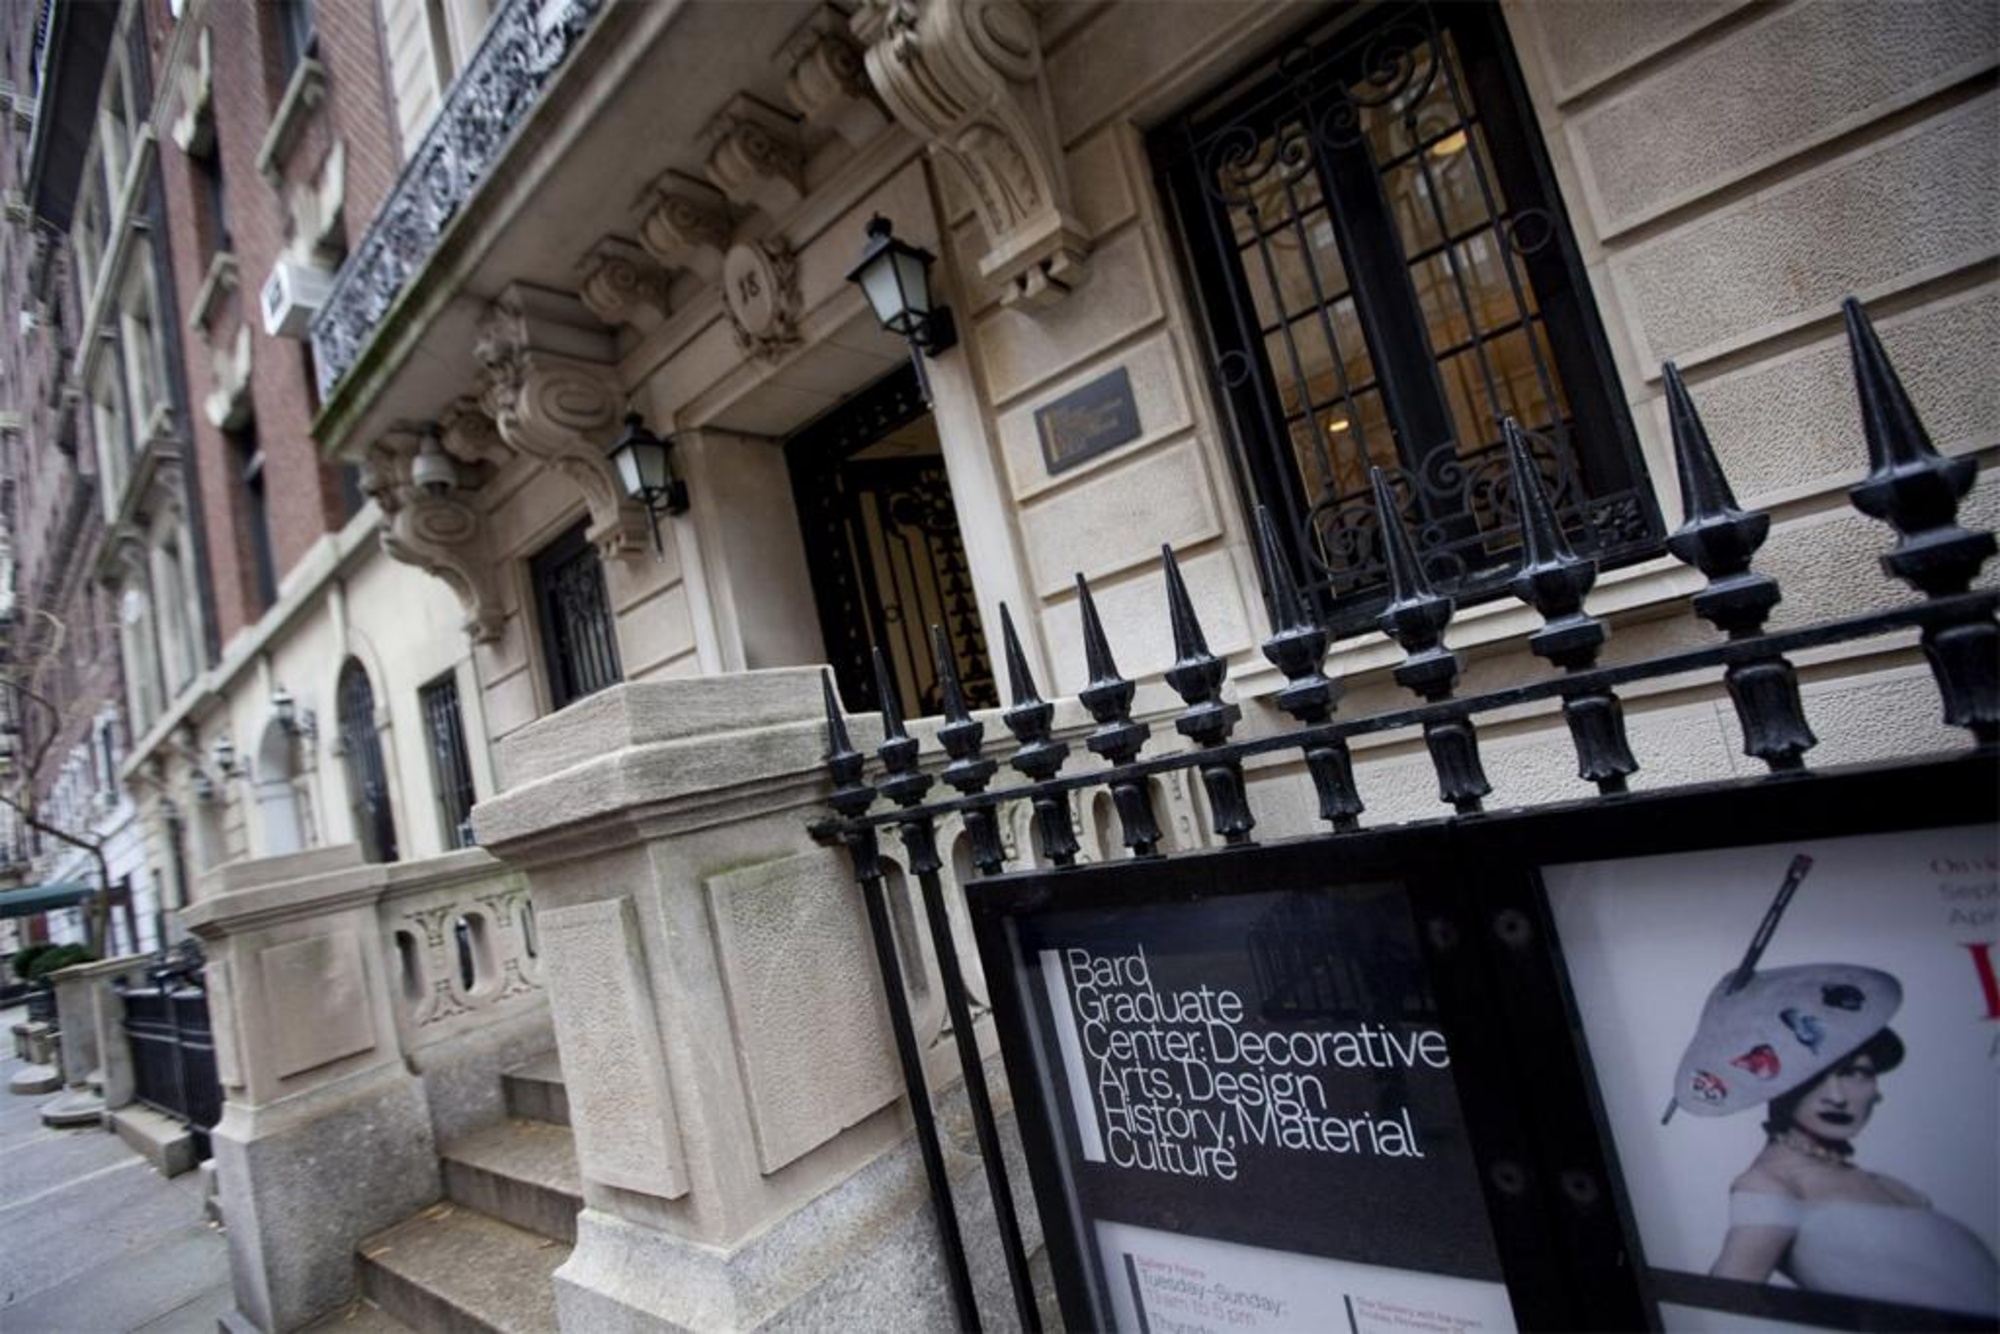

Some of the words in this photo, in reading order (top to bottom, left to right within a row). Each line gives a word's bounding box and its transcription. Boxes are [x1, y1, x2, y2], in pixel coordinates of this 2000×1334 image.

[1067, 943, 1151, 988] Bard
[1076, 982, 1244, 1025] Graduate
[1208, 1019, 1451, 1069] Decorative
[1098, 1057, 1182, 1104] Arts,
[1183, 1058, 1328, 1120] Design
[1102, 1092, 1236, 1150] History,
[1236, 1101, 1425, 1158] Material
[1107, 1125, 1238, 1181] Culture
